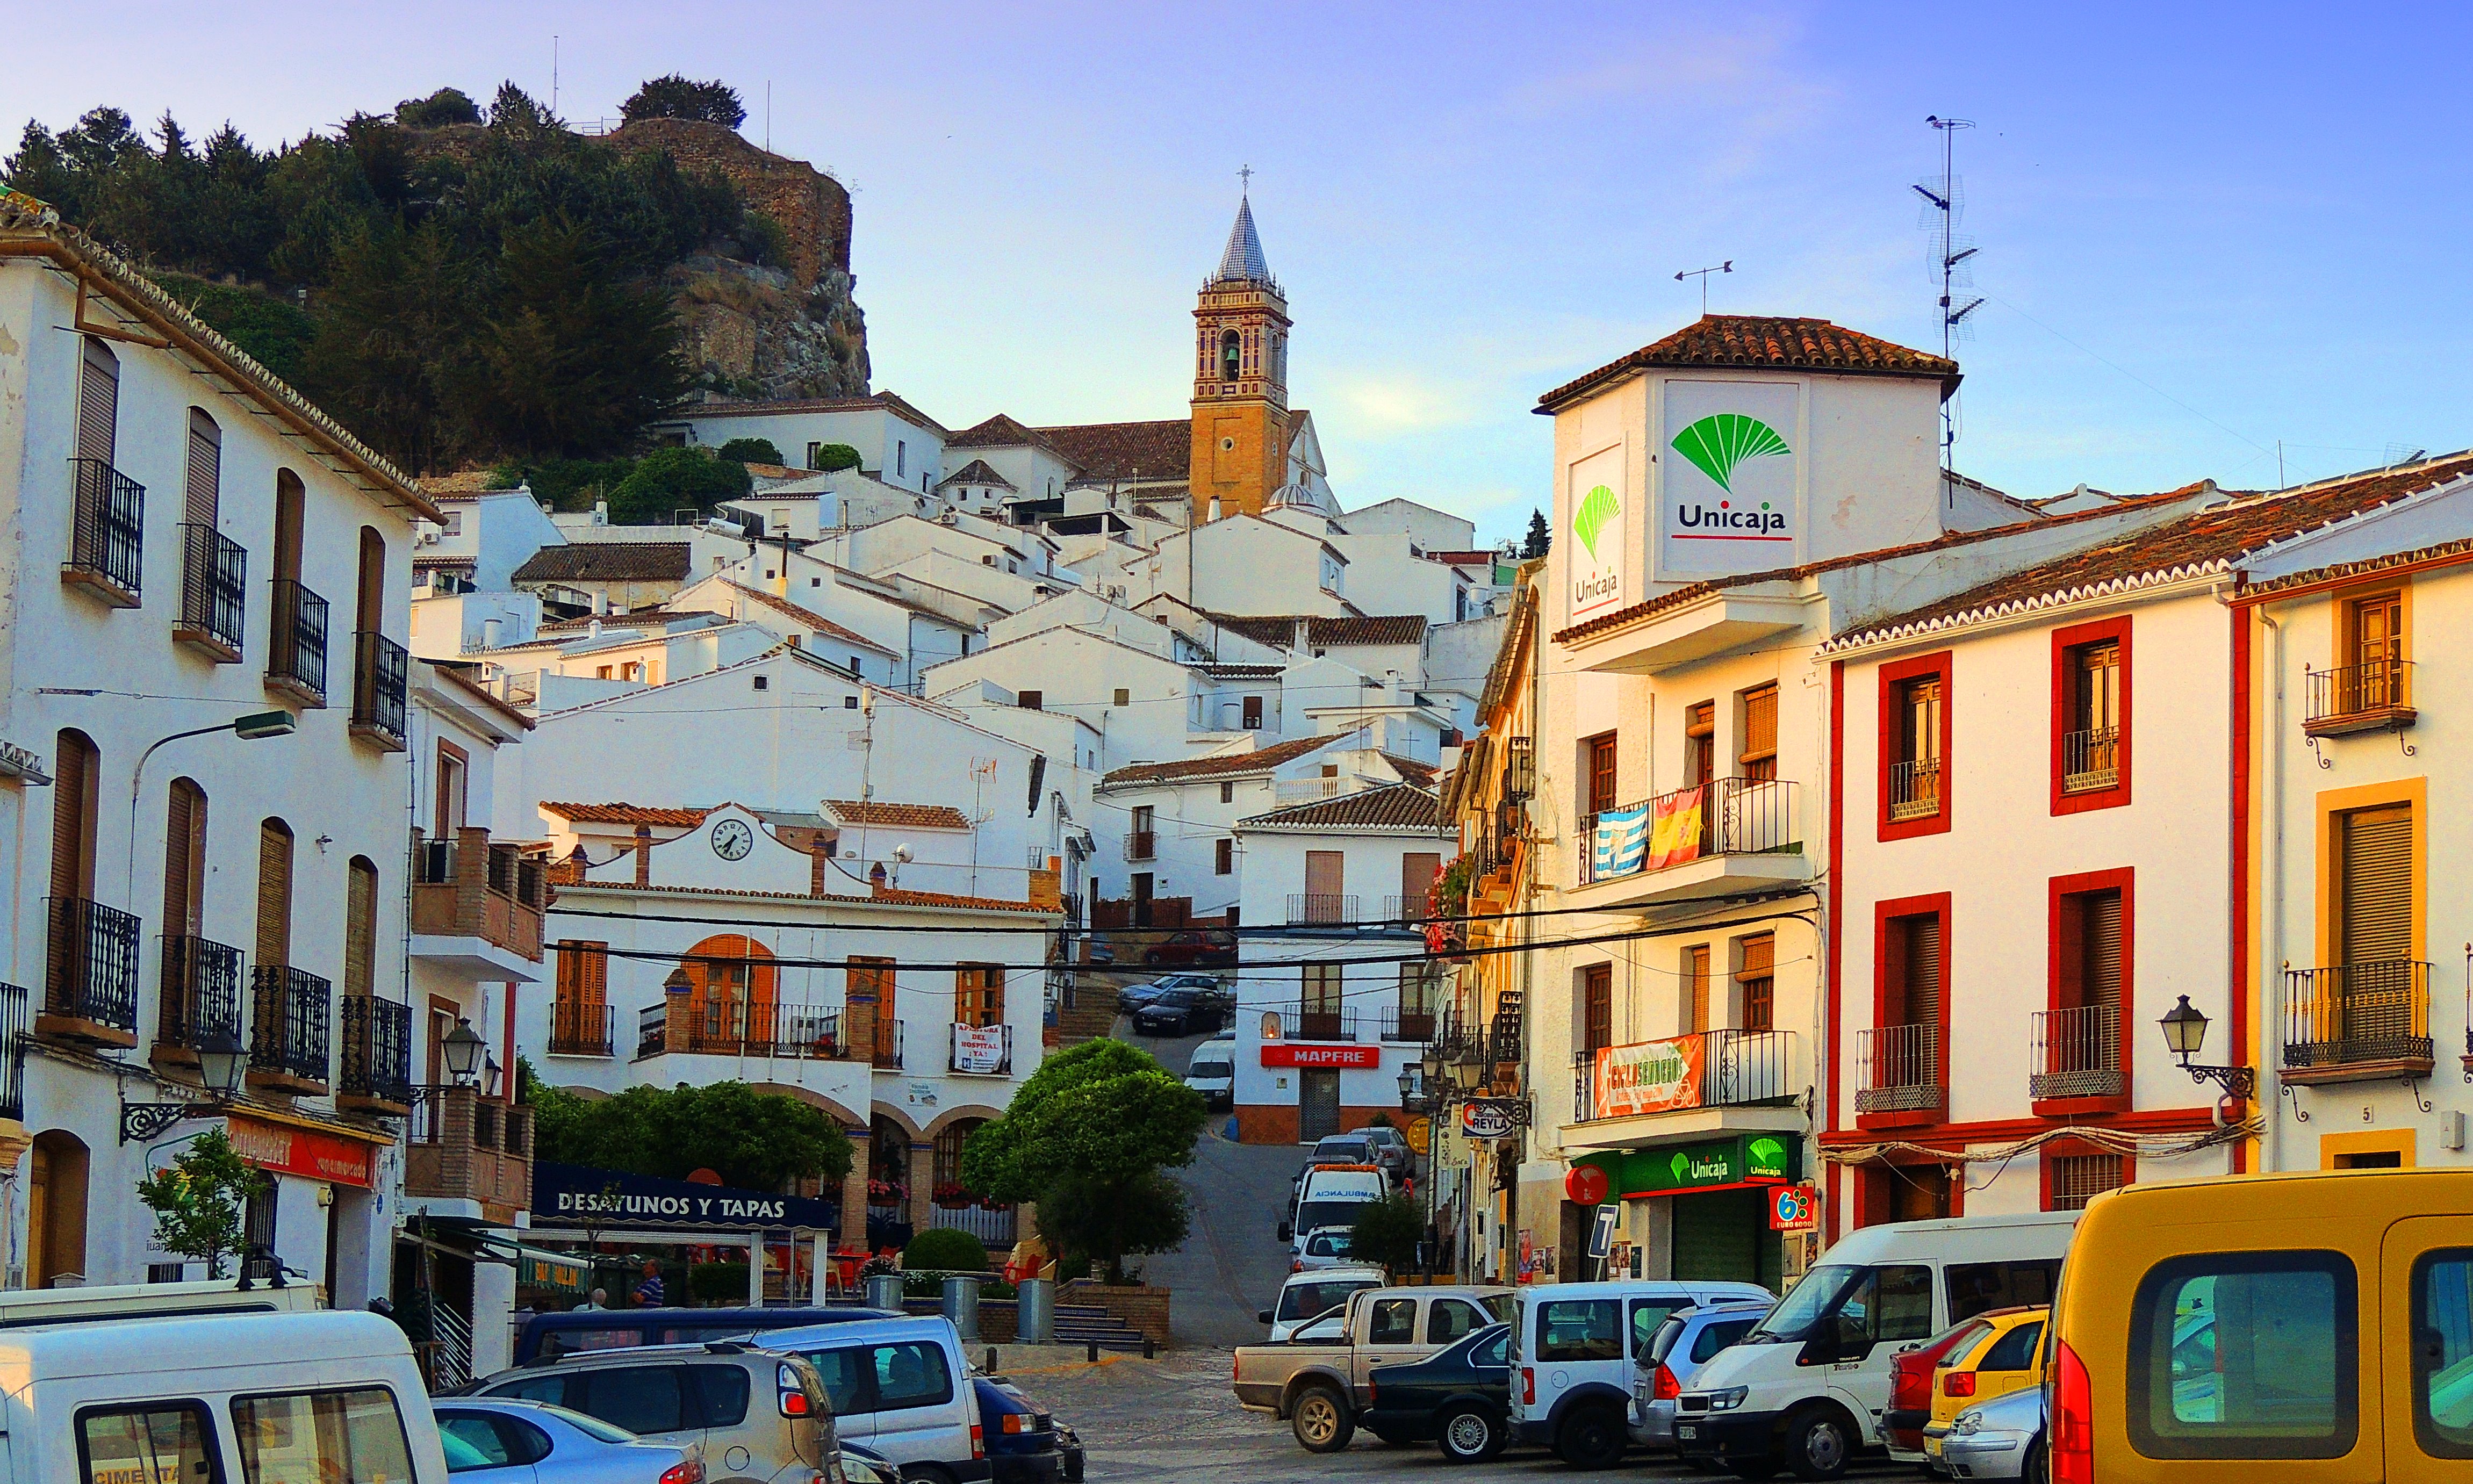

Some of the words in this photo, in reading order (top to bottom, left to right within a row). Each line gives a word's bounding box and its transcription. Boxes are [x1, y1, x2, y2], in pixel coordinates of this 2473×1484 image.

[1679, 500, 1786, 535] Unicaja
[1576, 566, 1617, 603] Unicaja
[961, 1041, 998, 1049] HOSPITAL
[1295, 1051, 1365, 1062] MAPFRE
[2363, 1107, 2370, 1121] 5
[1472, 1118, 1507, 1129] REYLA
[1691, 1154, 1728, 1182] Unicaja
[1750, 1165, 1781, 1177] Unicaja
[558, 1193, 689, 1214] DESAYUNOS
[698, 1198, 713, 1215] Y
[720, 1199, 785, 1218] TAPAS
